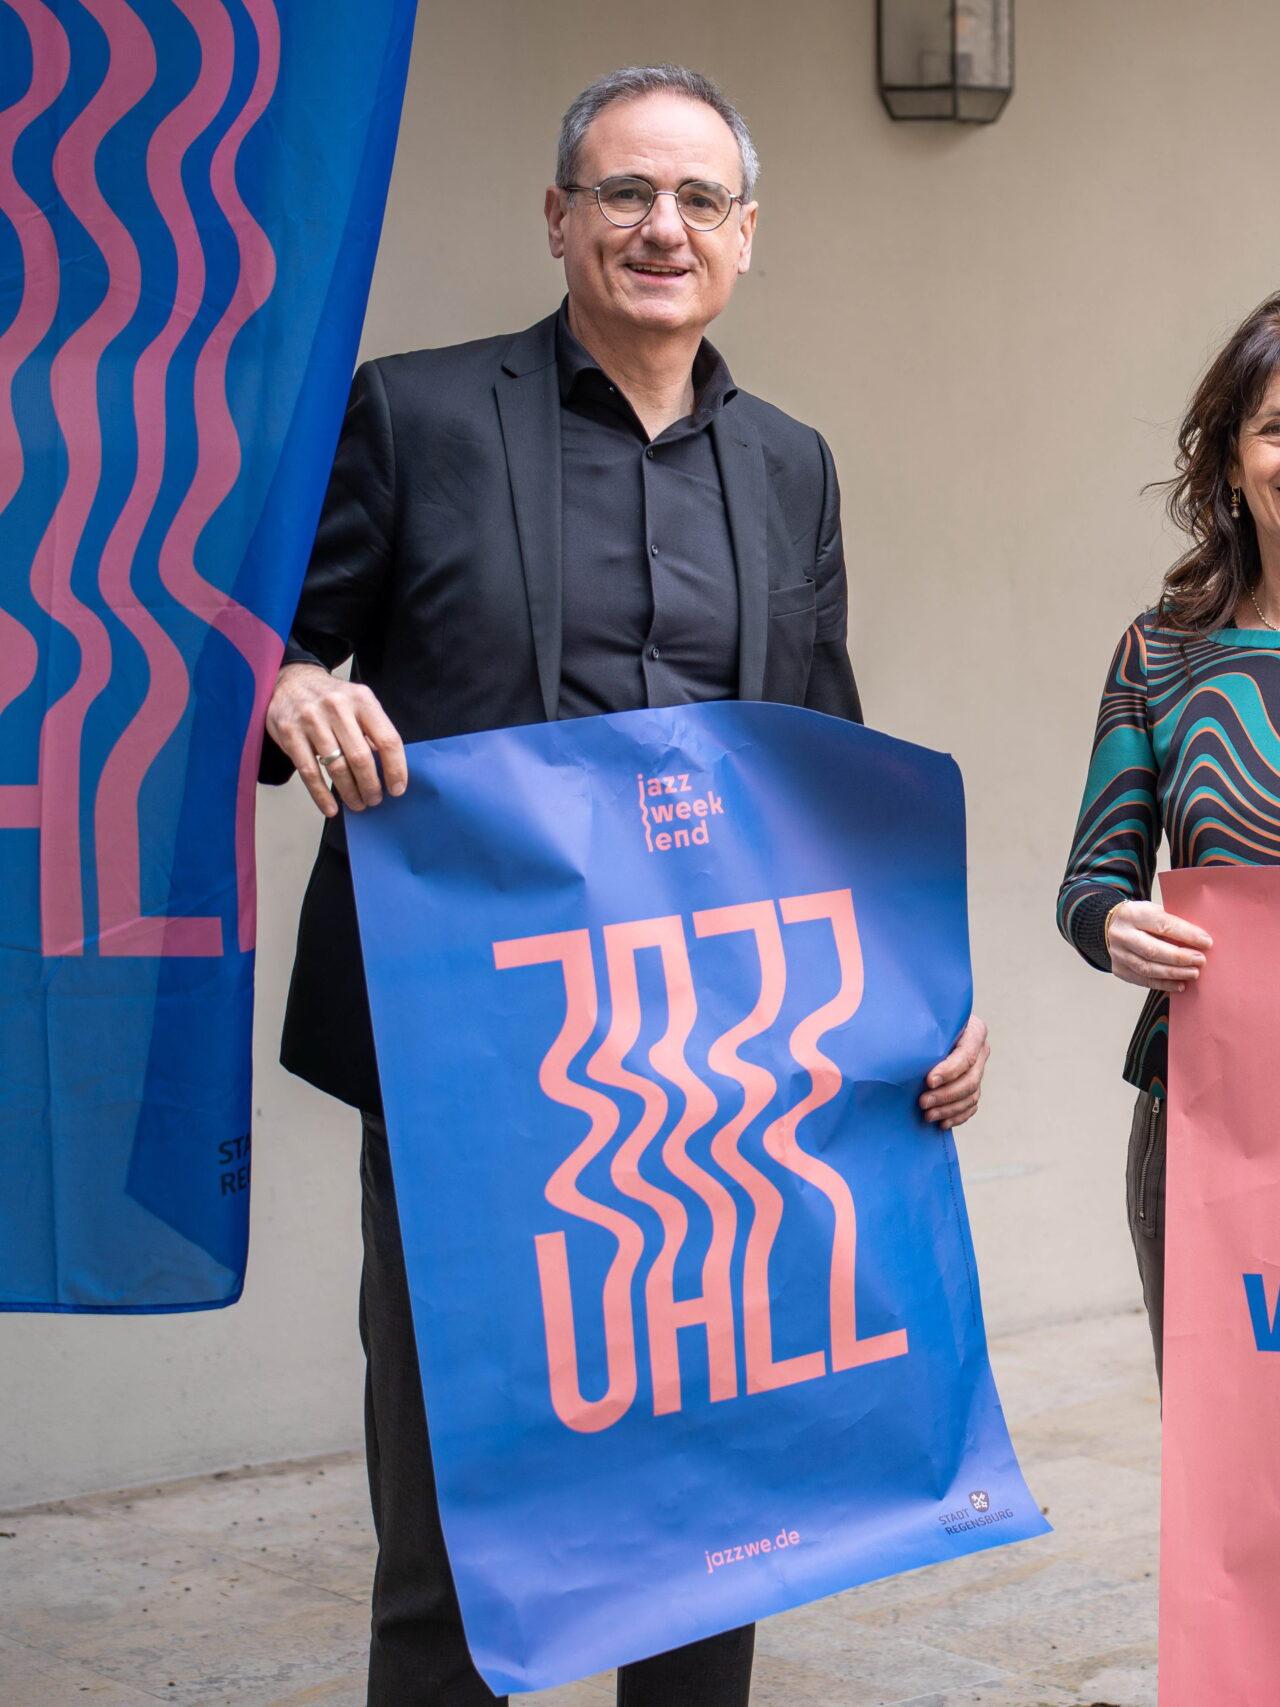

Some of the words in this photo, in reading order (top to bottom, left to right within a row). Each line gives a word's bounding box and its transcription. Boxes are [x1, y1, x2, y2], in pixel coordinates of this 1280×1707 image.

[650, 790, 725, 823] week
[655, 819, 710, 851] end
[938, 1507, 970, 1526] STADT
[945, 1507, 1014, 1536] REGENSBURG
[704, 1527, 800, 1573] jazzwe.de
